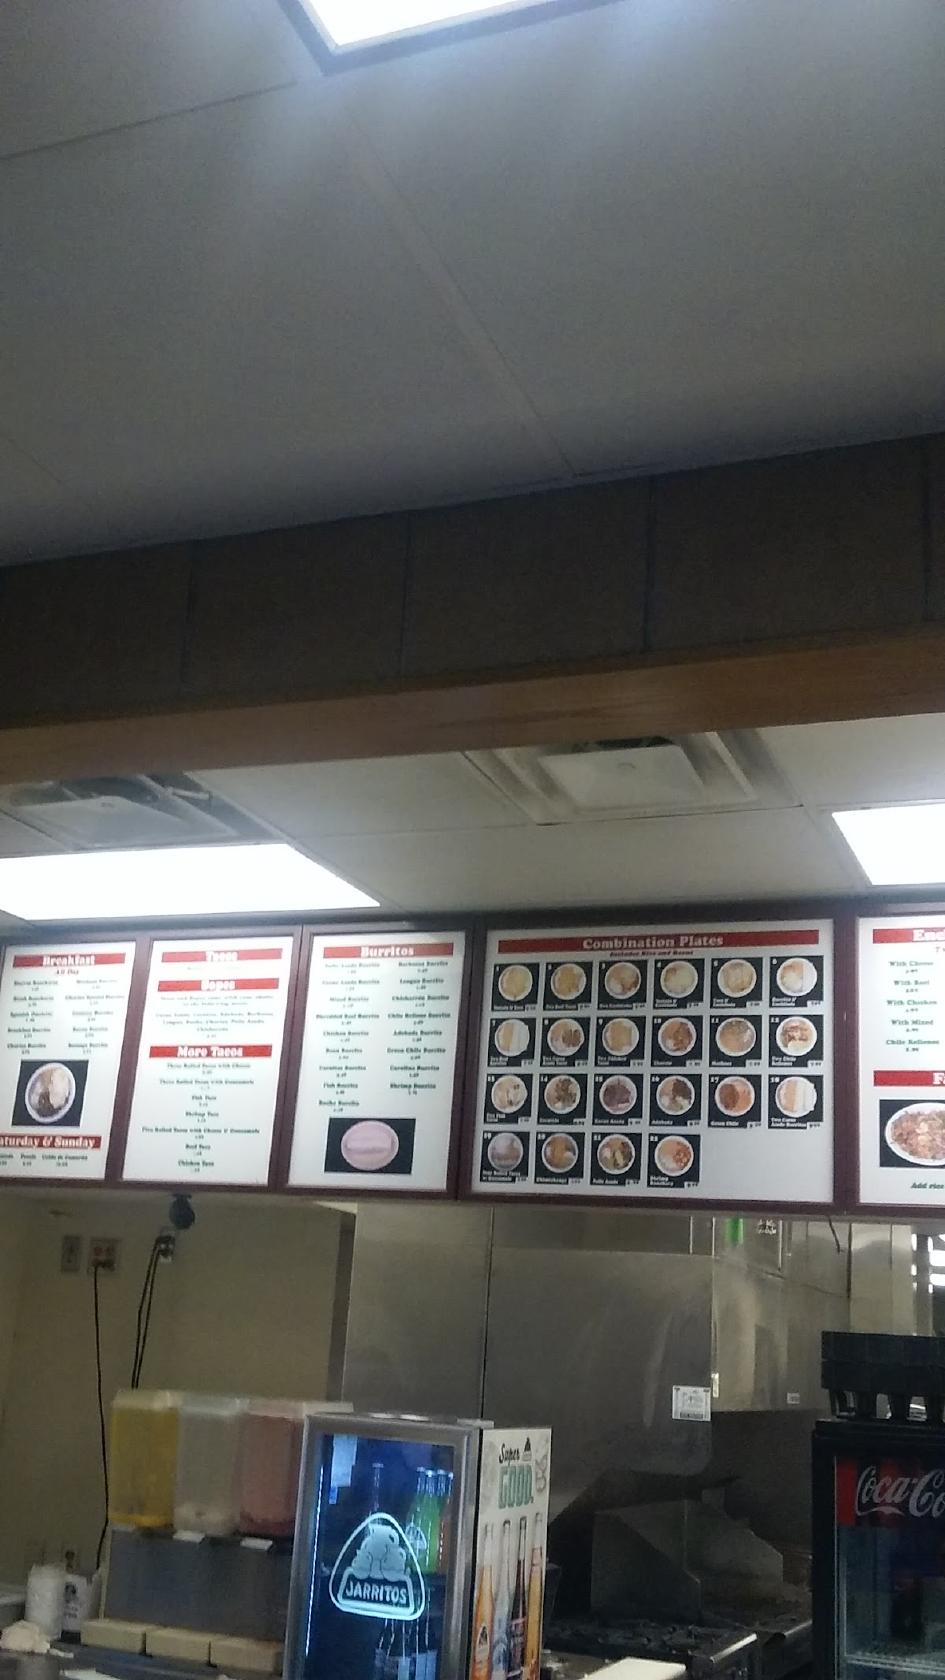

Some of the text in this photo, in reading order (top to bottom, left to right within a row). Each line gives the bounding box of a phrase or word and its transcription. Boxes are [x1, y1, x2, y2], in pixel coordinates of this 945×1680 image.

[583, 935, 723, 950] Combination Plates
[361, 946, 413, 957] Burritos
[43, 954, 95, 967] Breakfast
[178, 1046, 243, 1057] More Tacos
[54, 1136, 95, 1150] Sunday
[345, 1581, 407, 1604] JARRITOS
